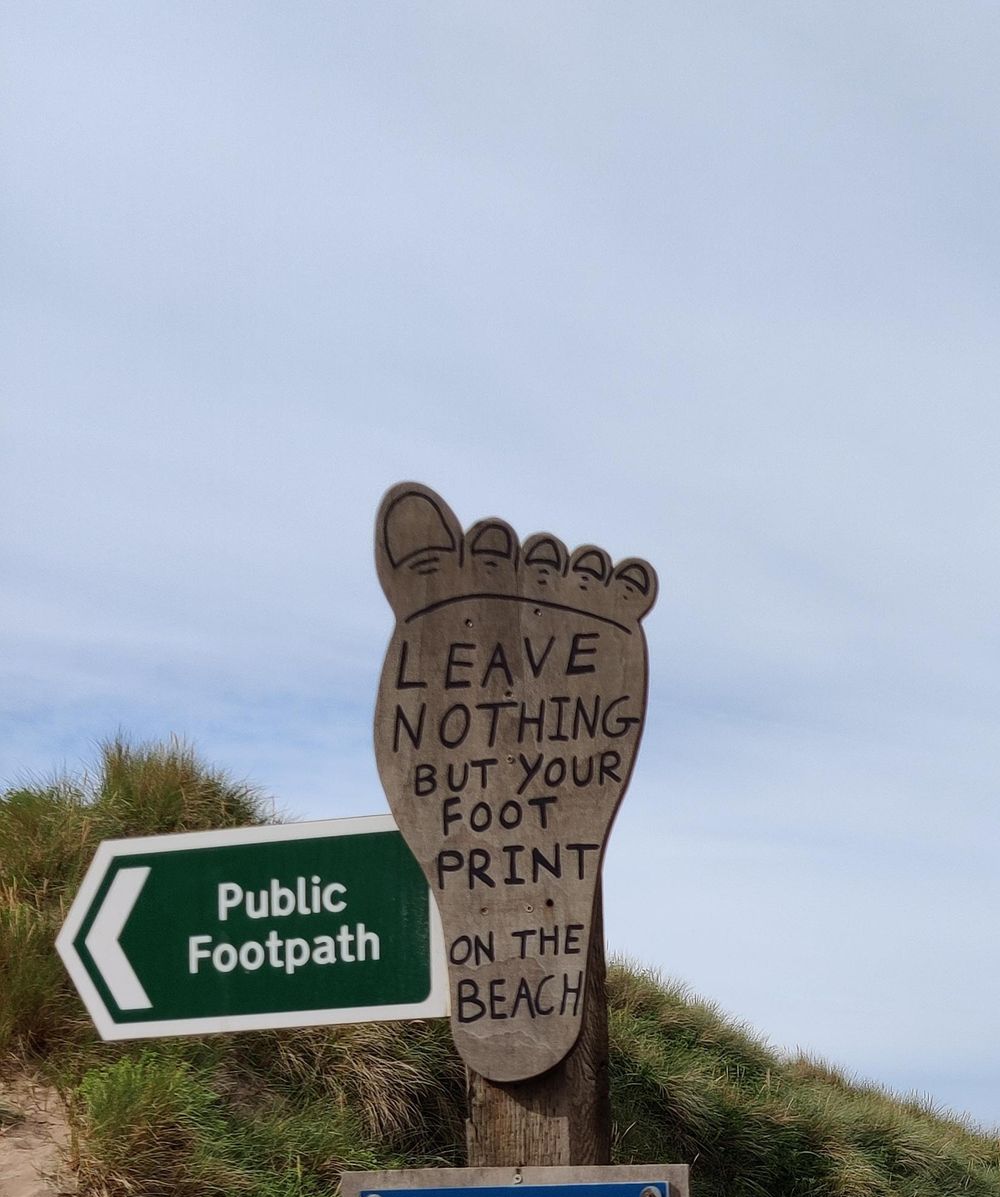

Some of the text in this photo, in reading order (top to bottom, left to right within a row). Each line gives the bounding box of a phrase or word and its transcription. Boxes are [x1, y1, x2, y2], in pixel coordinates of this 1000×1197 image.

[397, 632, 600, 690] LEAVE
[393, 695, 641, 752] NOTHING
[414, 750, 623, 797] BUT YOUR
[442, 797, 558, 836] FOOT
[436, 842, 600, 890] PRINT
[218, 875, 347, 921] Public
[188, 922, 380, 975] Footpath
[449, 924, 584, 966] ON THE
[457, 970, 584, 1023] BEACH
